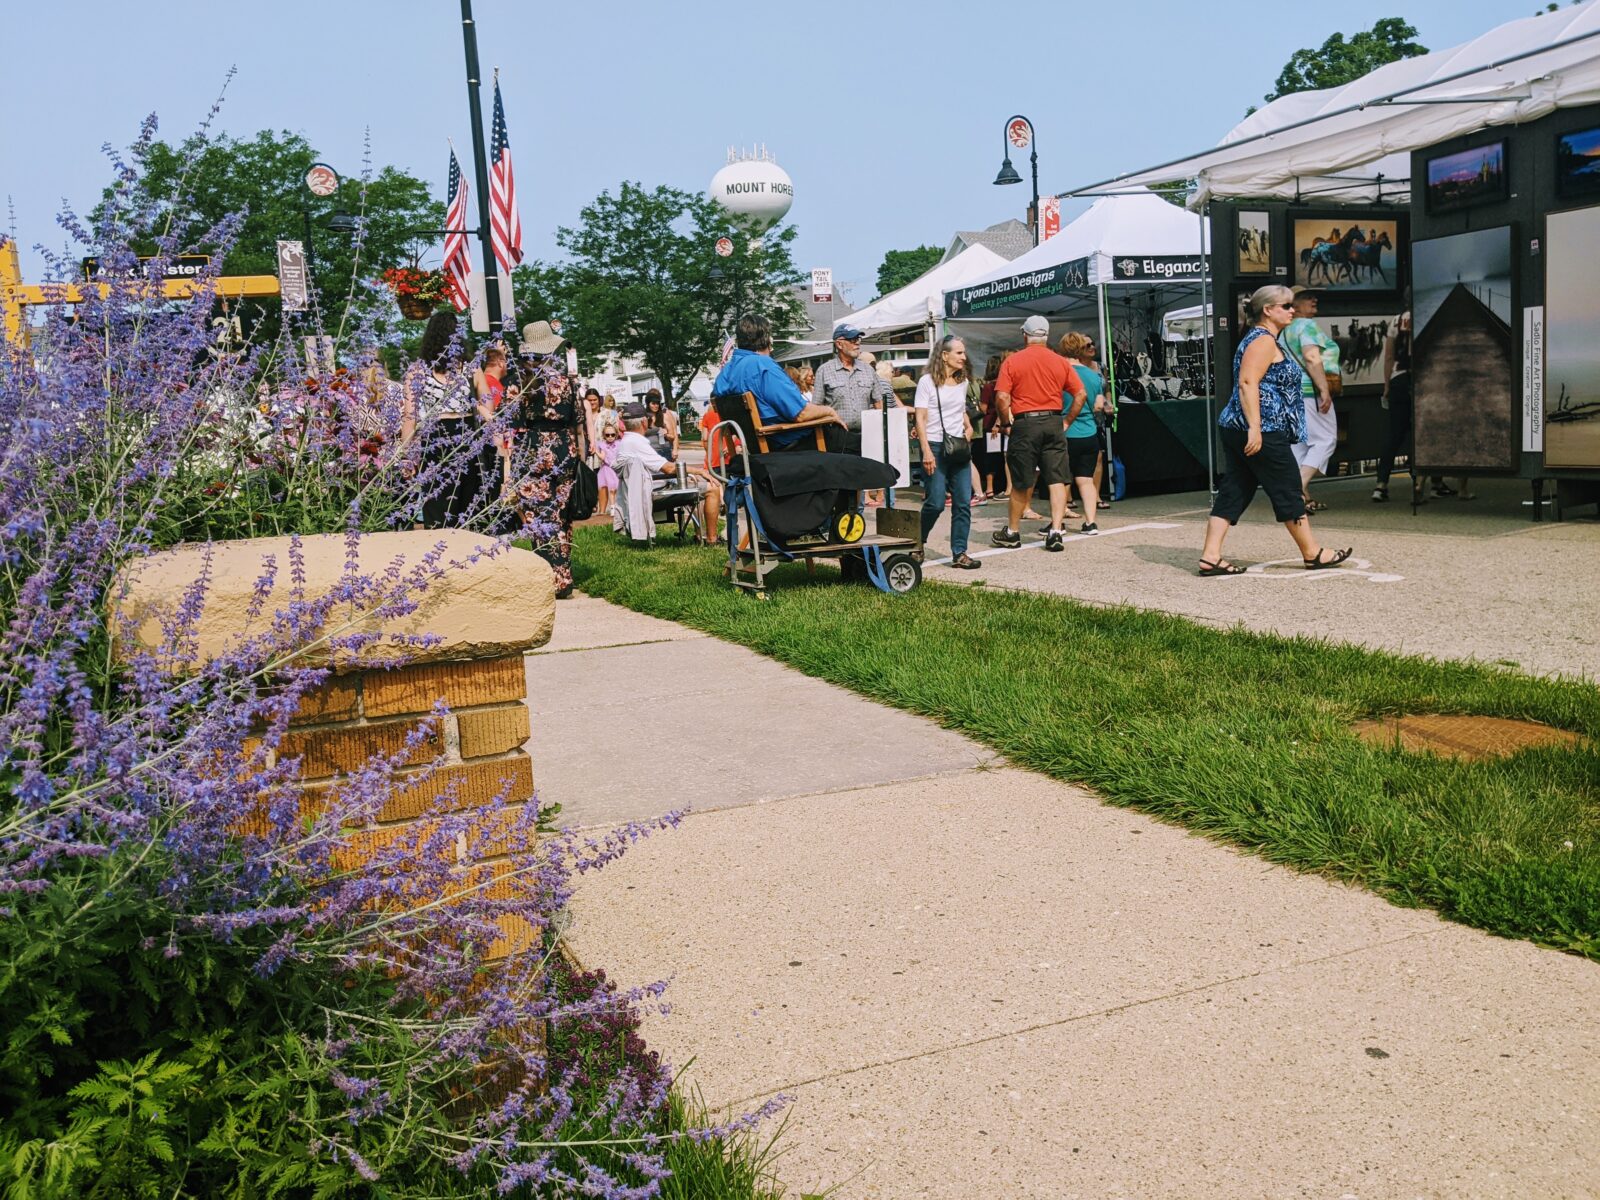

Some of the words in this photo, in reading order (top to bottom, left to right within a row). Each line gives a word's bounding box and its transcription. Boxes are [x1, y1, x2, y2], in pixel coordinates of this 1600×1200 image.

[726, 182, 766, 195] MOUNT
[1142, 259, 1210, 278] Elegance
[962, 286, 989, 303] Lyons
[991, 280, 1010, 295] Den
[1012, 270, 1055, 288] Designs
[1533, 321, 1541, 345] Sadlo
[1533, 347, 1541, 365] Fine
[1533, 367, 1541, 380] Art
[1532, 382, 1541, 434] Photography
